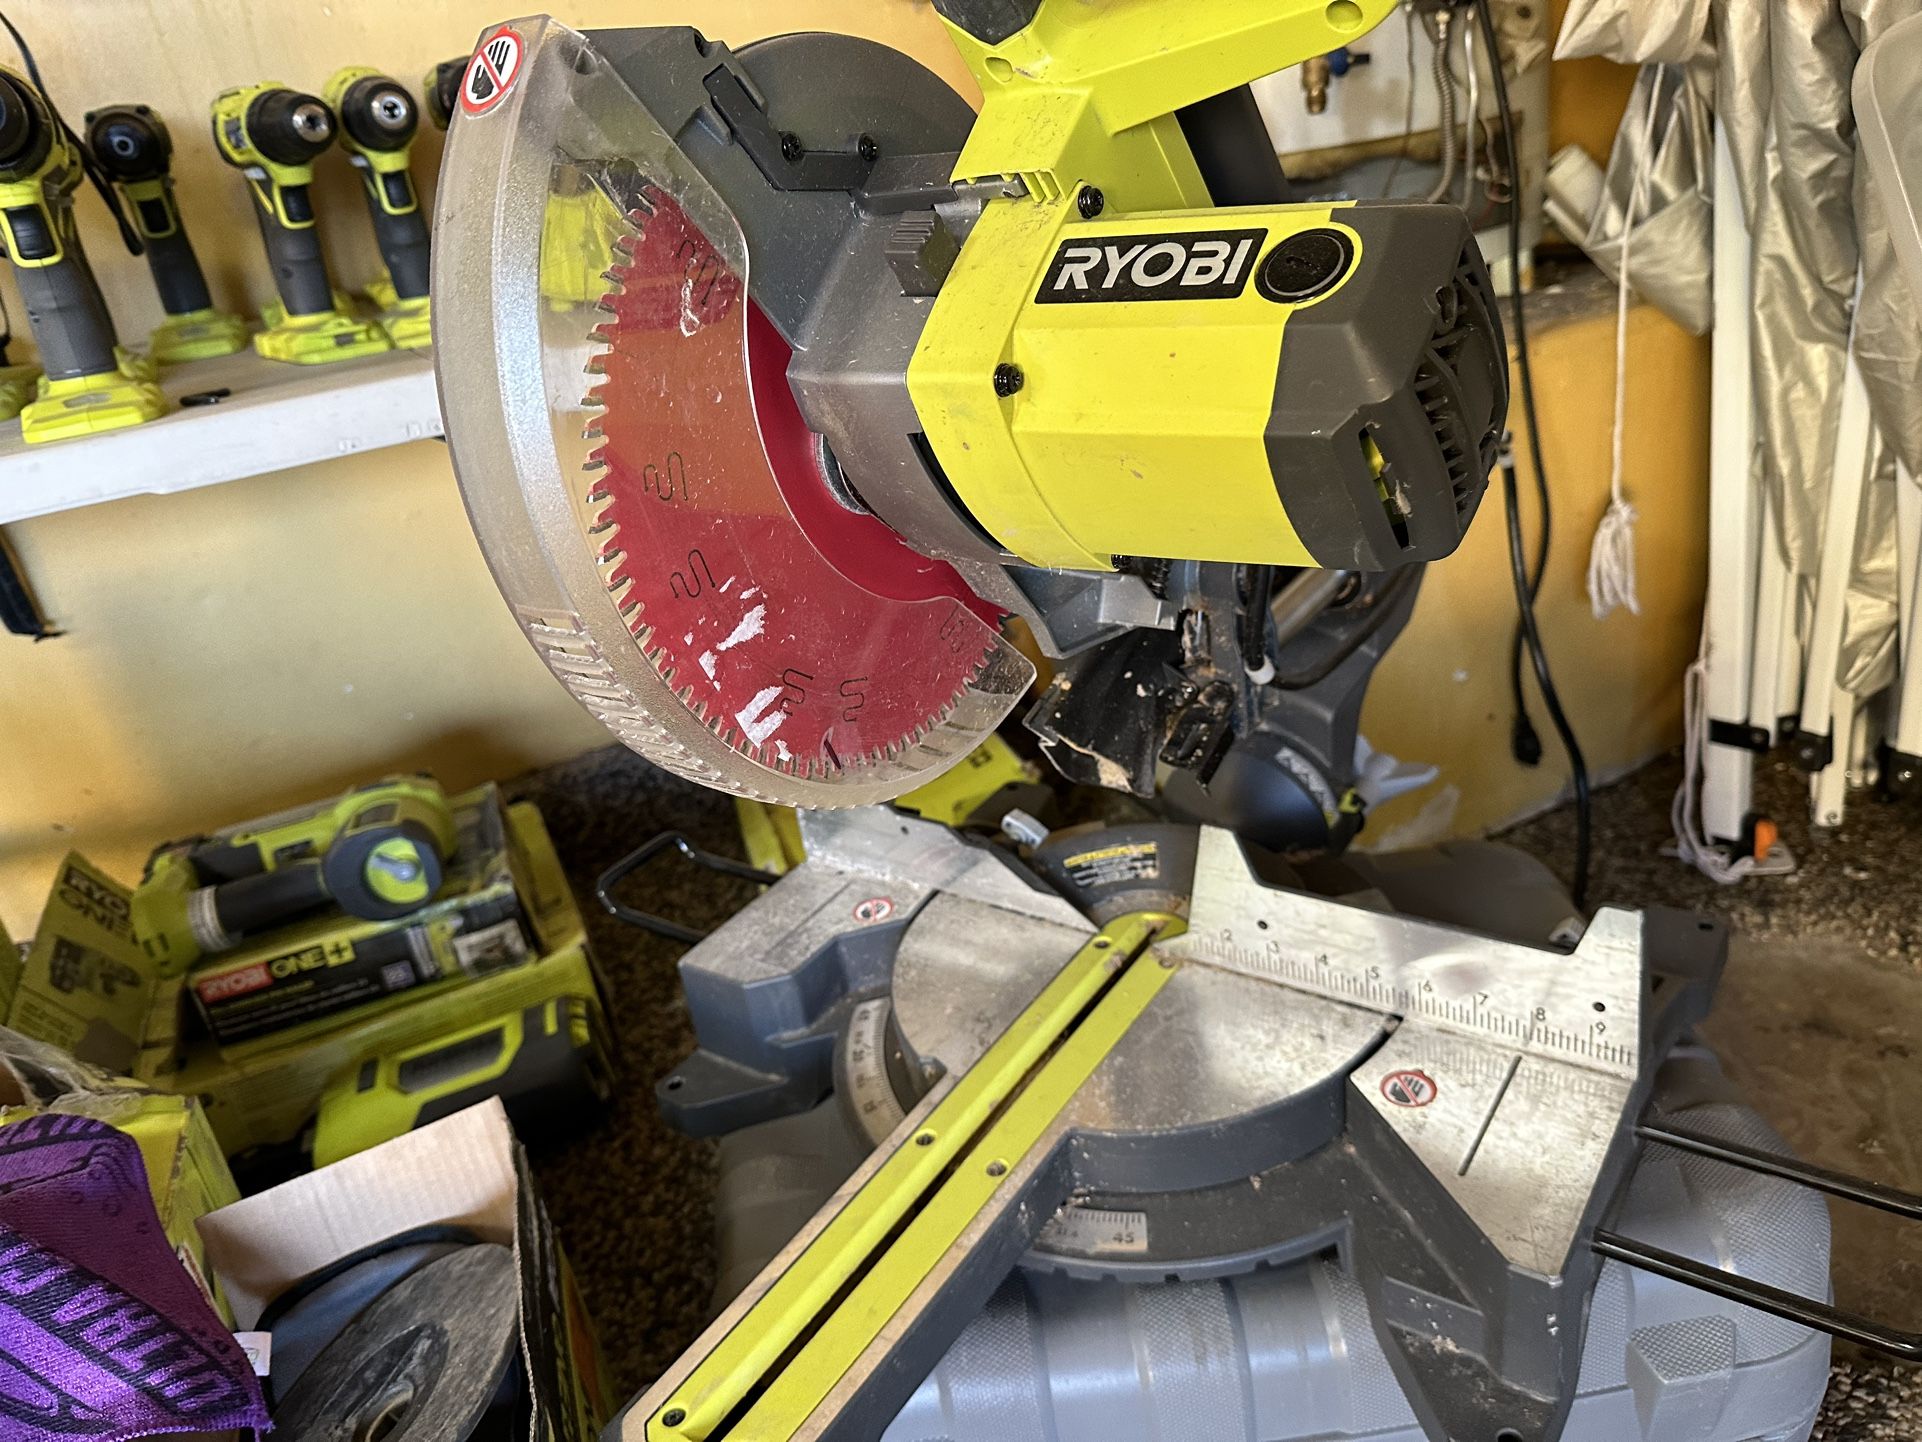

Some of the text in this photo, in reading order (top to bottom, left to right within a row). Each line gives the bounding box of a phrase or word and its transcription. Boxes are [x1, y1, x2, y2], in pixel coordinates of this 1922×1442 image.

[1053, 238, 1254, 291] RYOBI
[1222, 928, 1606, 1035] 2 3 4 5 6 7 8 9
[1112, 1231, 1134, 1245] 45
